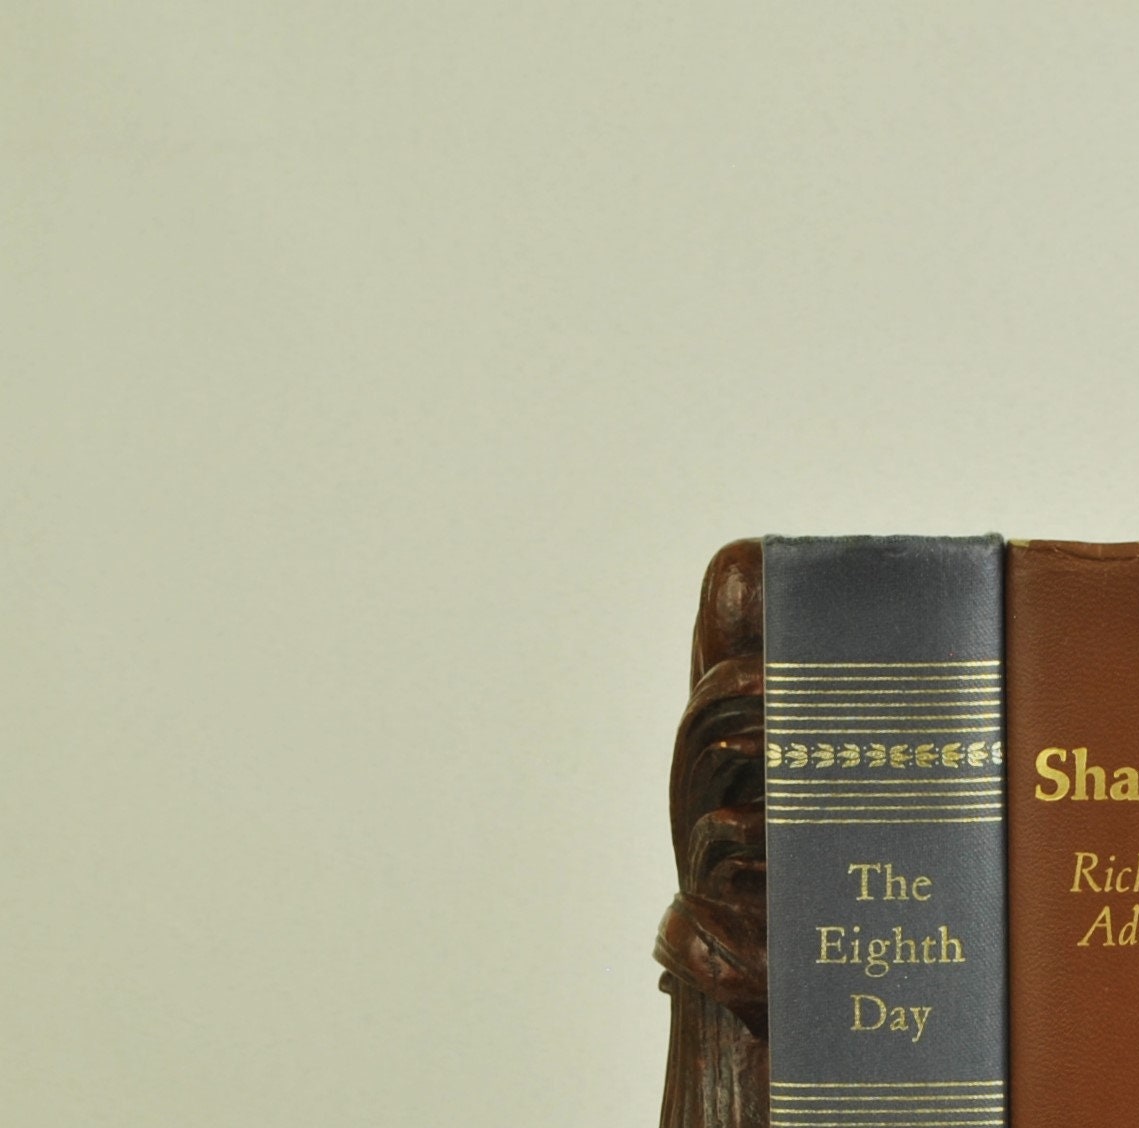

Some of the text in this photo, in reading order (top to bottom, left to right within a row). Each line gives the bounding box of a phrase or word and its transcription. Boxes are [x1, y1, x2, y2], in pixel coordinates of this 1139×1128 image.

[847, 863, 933, 901] The
[815, 926, 966, 978] Eighth
[850, 994, 933, 1043] Day
